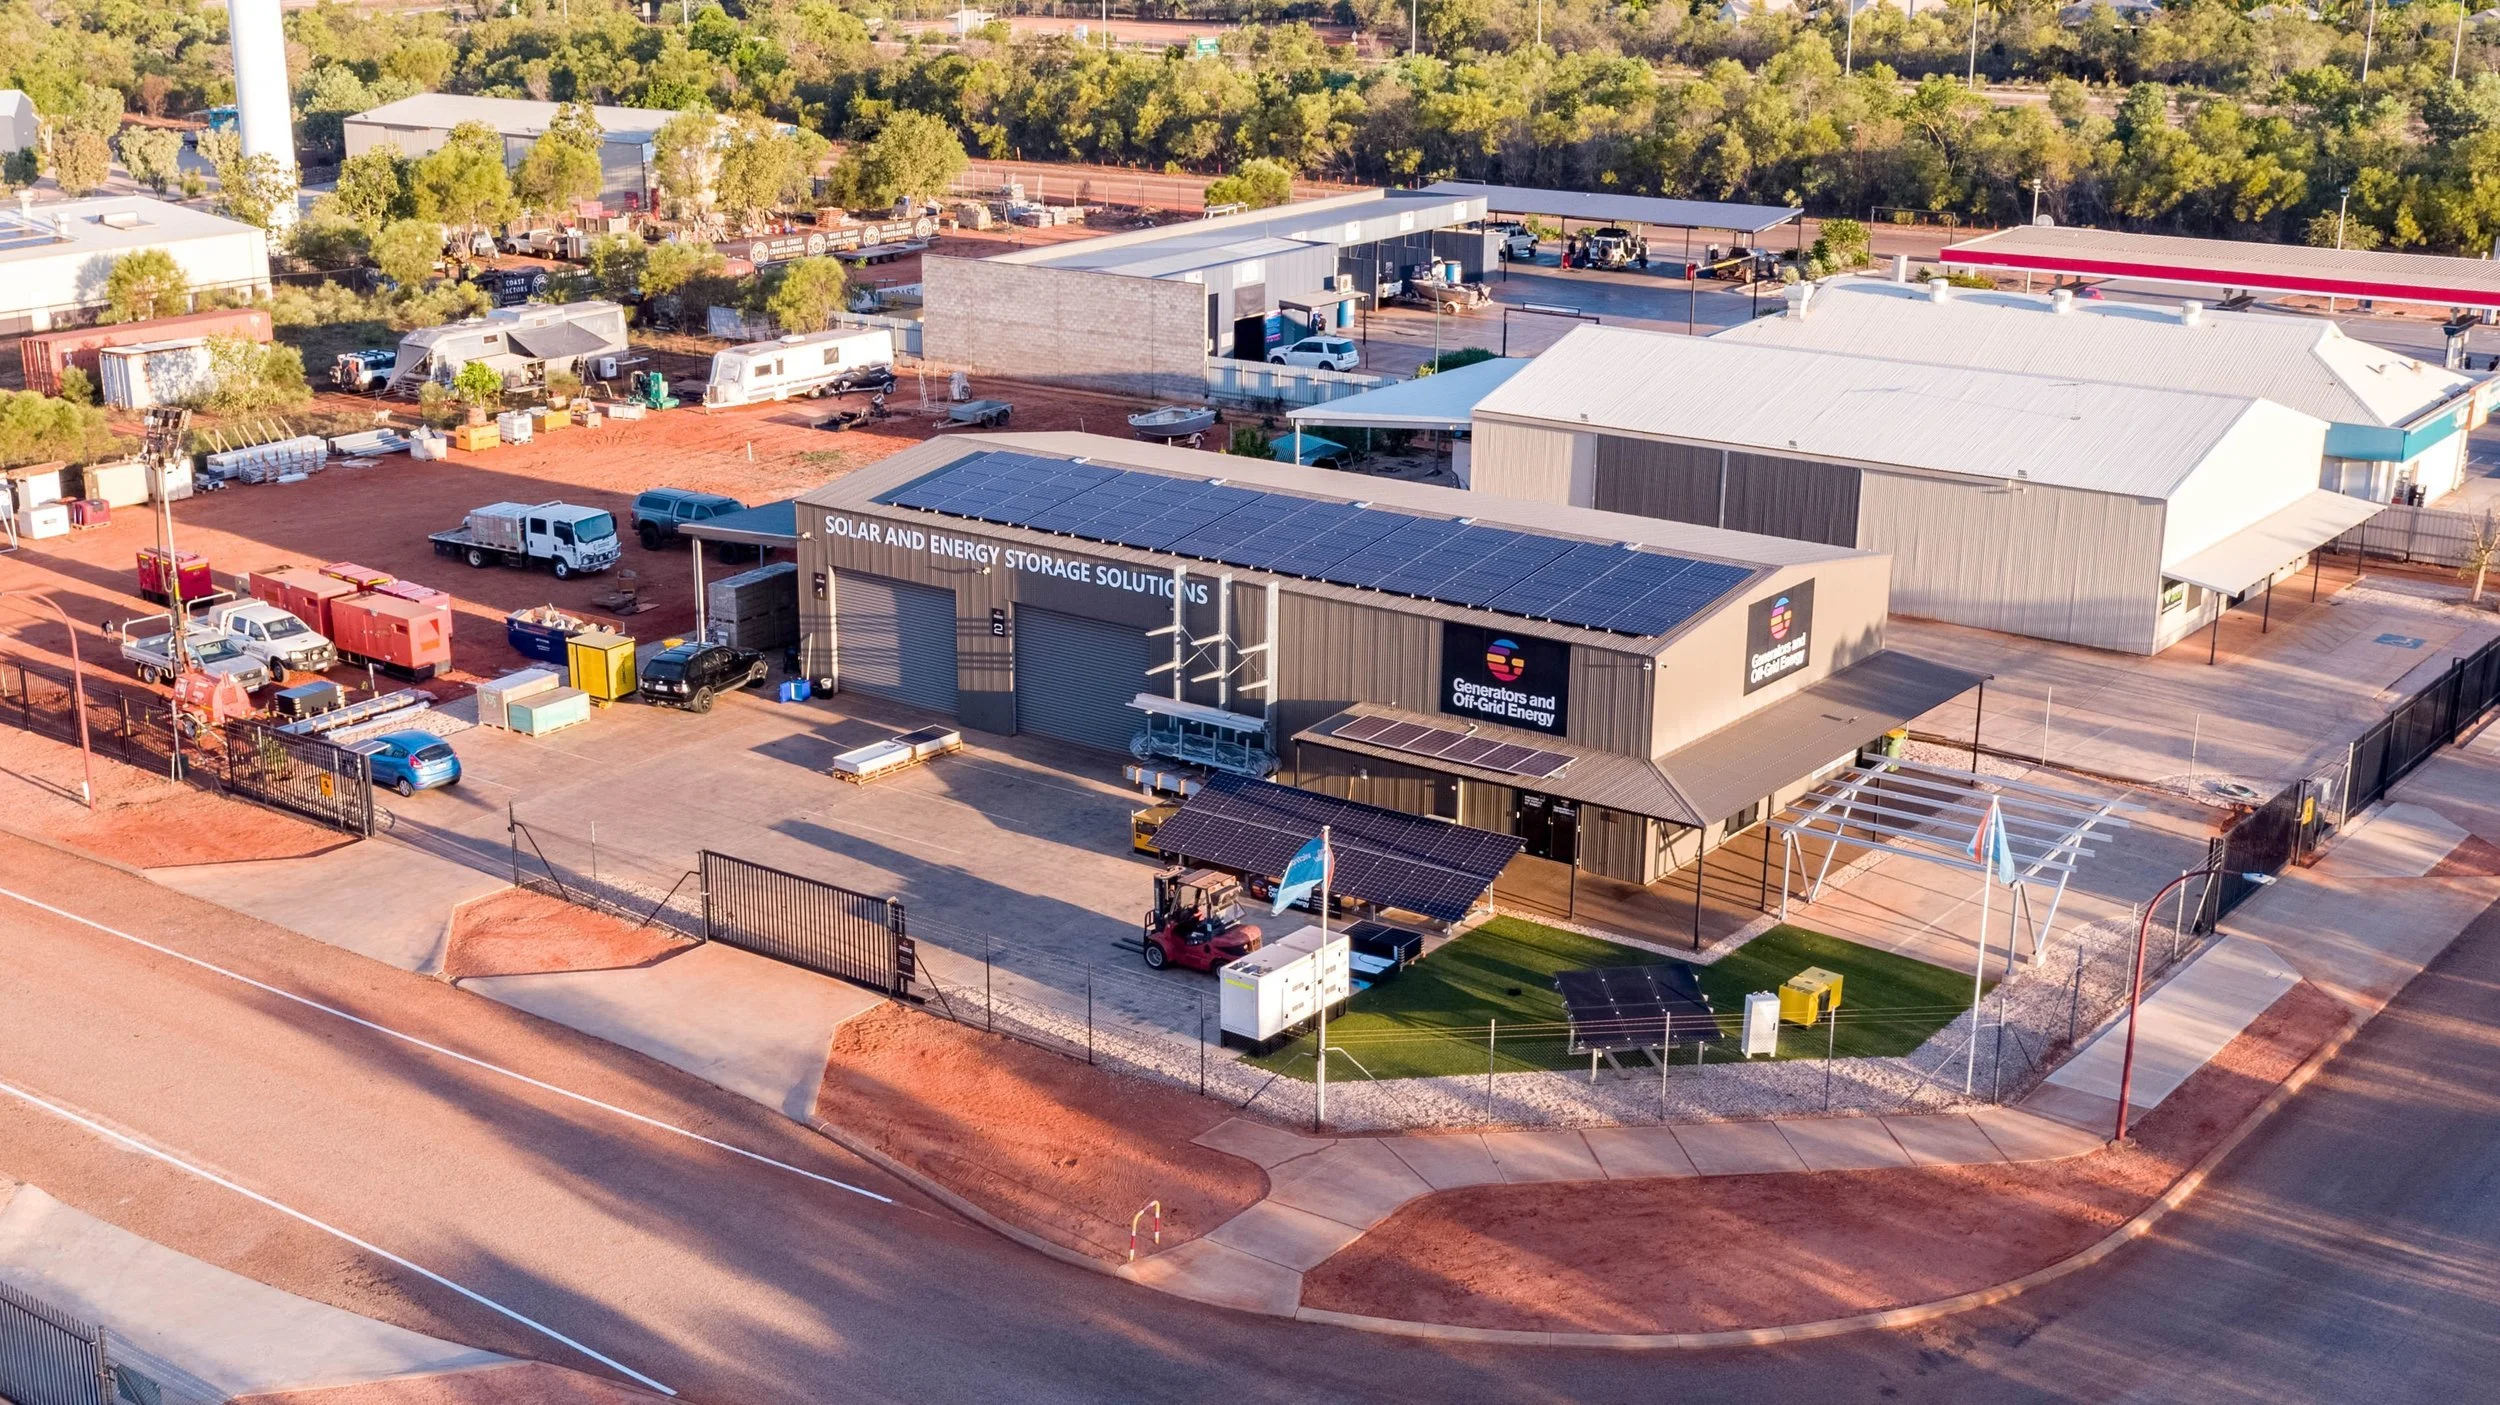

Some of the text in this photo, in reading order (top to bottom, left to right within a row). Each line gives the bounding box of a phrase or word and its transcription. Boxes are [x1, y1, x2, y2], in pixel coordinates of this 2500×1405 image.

[825, 515, 1208, 604] SOLAR AND ENERGY STORAGE SOLUTIONS
[817, 587, 823, 598] 1
[993, 622, 1003, 635] 2
[1751, 631, 1806, 669] Generators and
[1453, 677, 1555, 710] Generators and
[1453, 692, 1555, 727] Off-Grid Energy
